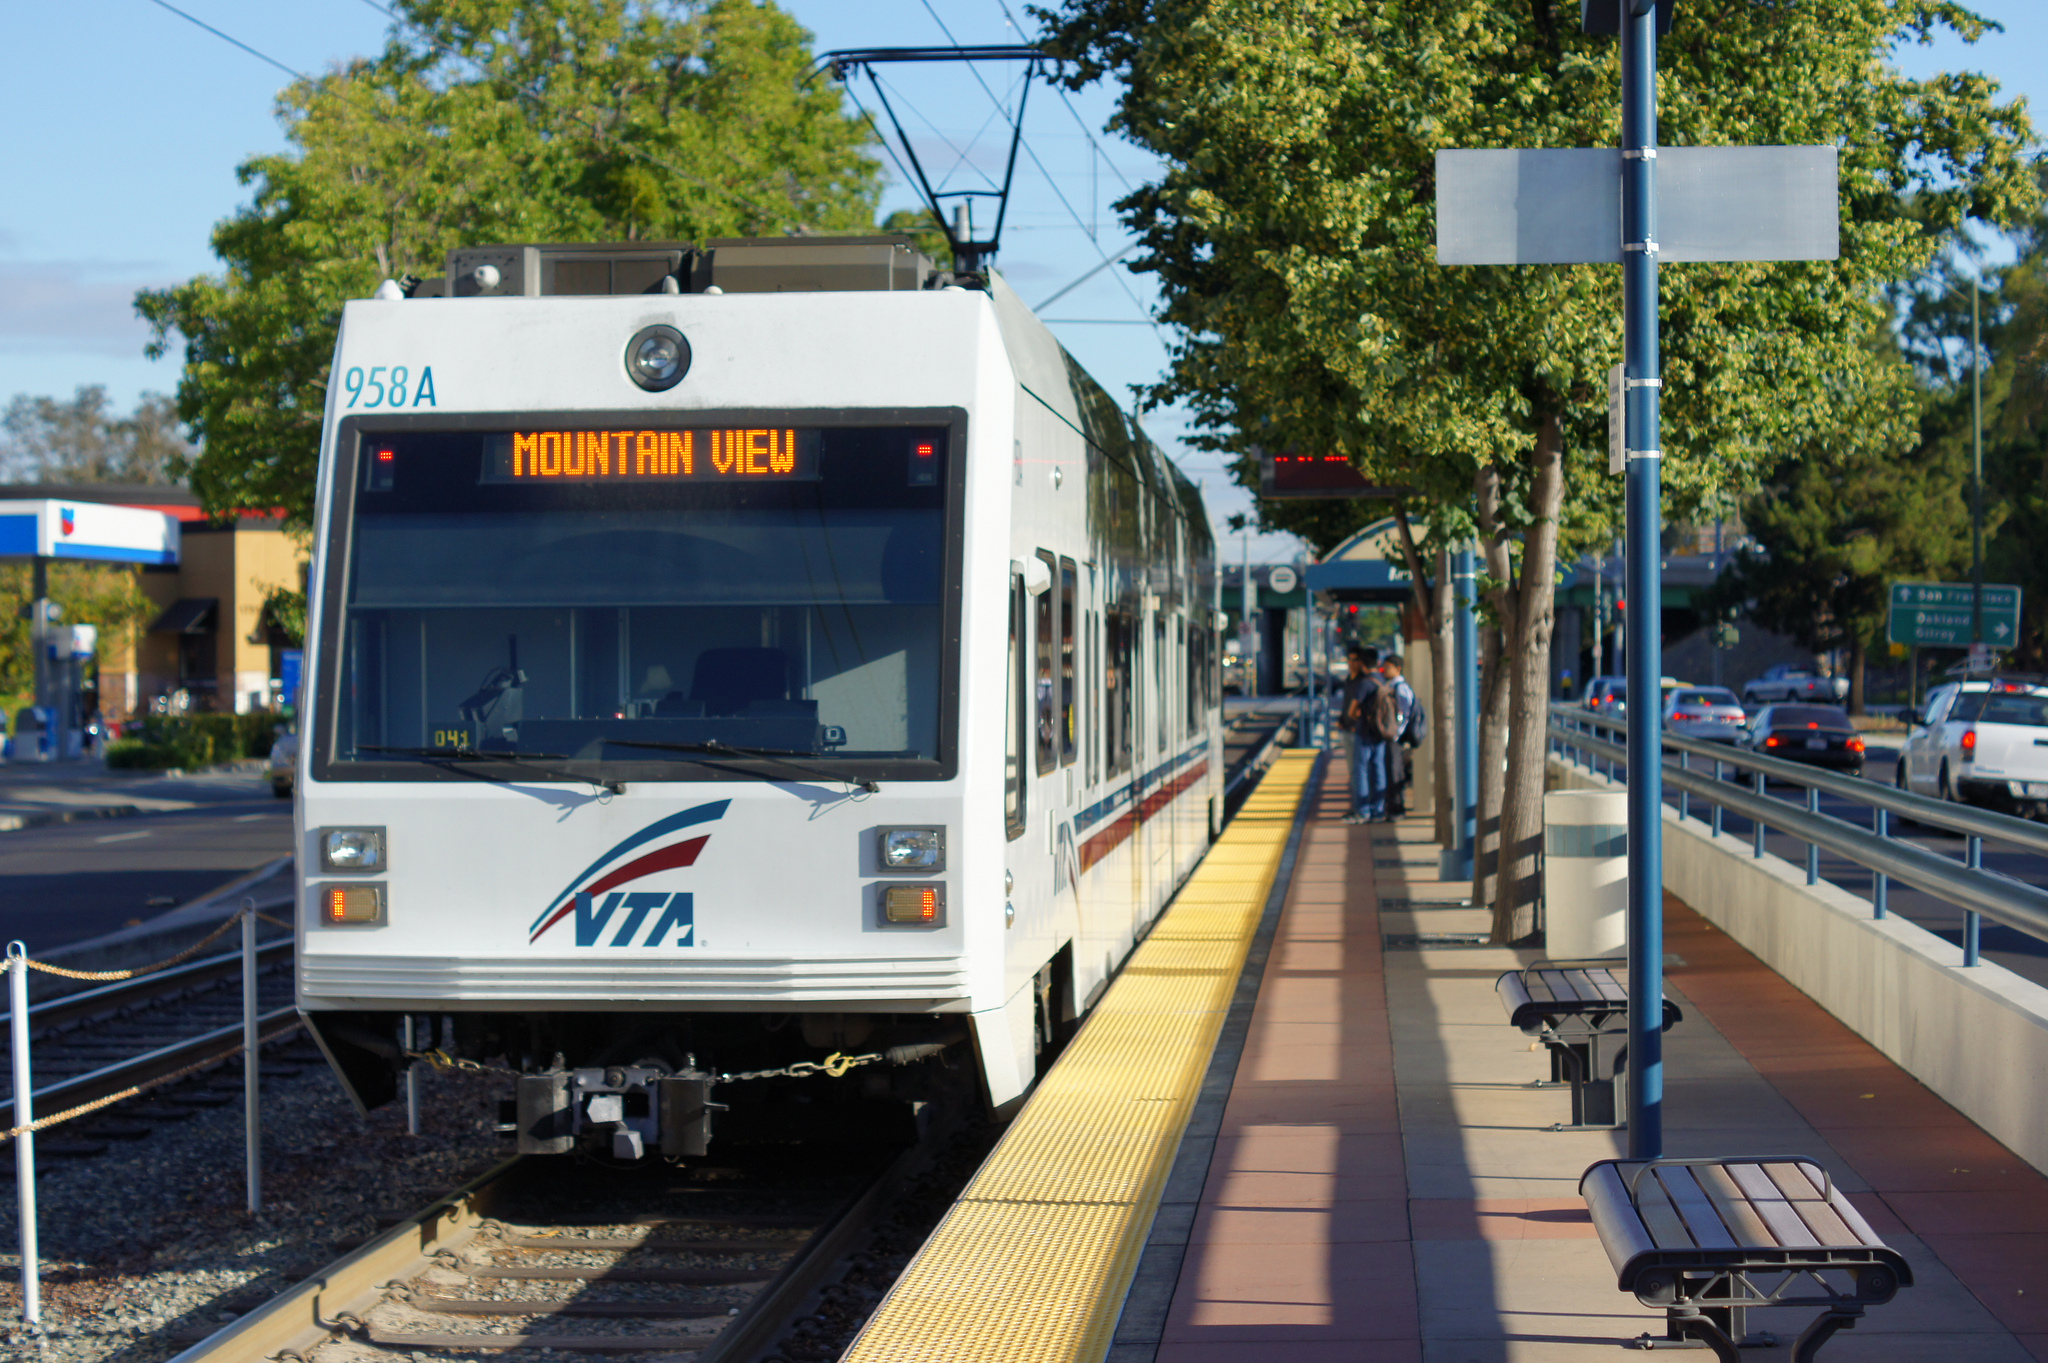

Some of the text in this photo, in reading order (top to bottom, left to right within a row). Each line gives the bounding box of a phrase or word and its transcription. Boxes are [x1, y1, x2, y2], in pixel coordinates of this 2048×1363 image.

[345, 365, 437, 409] 958A
[513, 429, 795, 476] MOUNTAIN VIEW
[1918, 589, 2012, 604] San Fraisco
[1916, 612, 1970, 625] Oakland
[435, 730, 471, 747] 041
[574, 891, 694, 948] VTA
